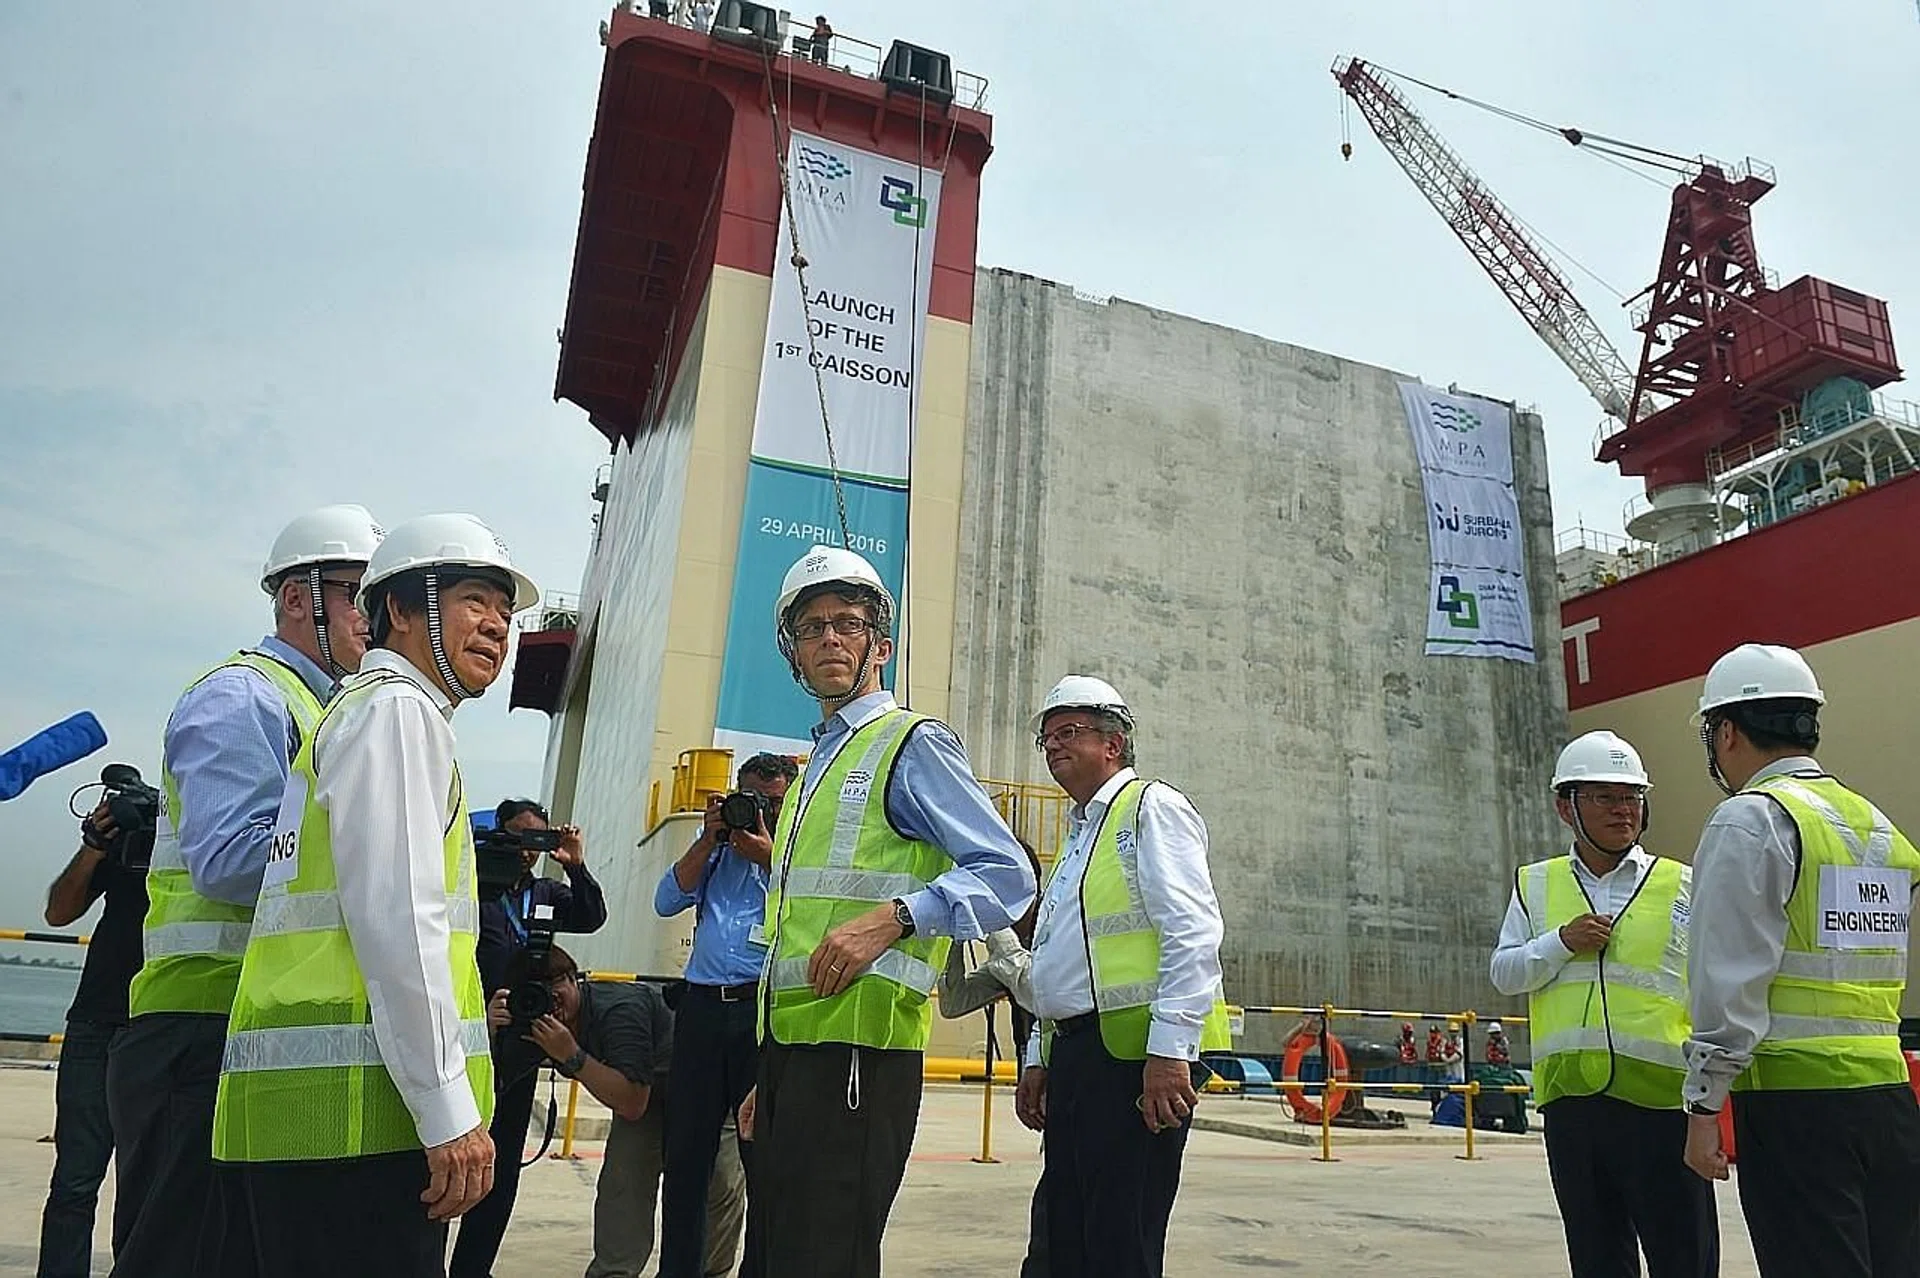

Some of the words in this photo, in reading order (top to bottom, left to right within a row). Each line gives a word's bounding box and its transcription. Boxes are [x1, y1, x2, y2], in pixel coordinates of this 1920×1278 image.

[796, 180, 846, 205] MPA
[803, 286, 895, 325] LAUNCH
[809, 319, 838, 340] OF
[842, 327, 885, 353] THE
[775, 342, 803, 359] 1ST
[808, 352, 910, 388] CAISSON
[760, 517, 783, 535] 29
[786, 523, 841, 547] APRIL
[847, 534, 887, 554] 2016
[1858, 883, 1890, 904] MPA
[1824, 910, 1909, 933] ENGINEERIN
